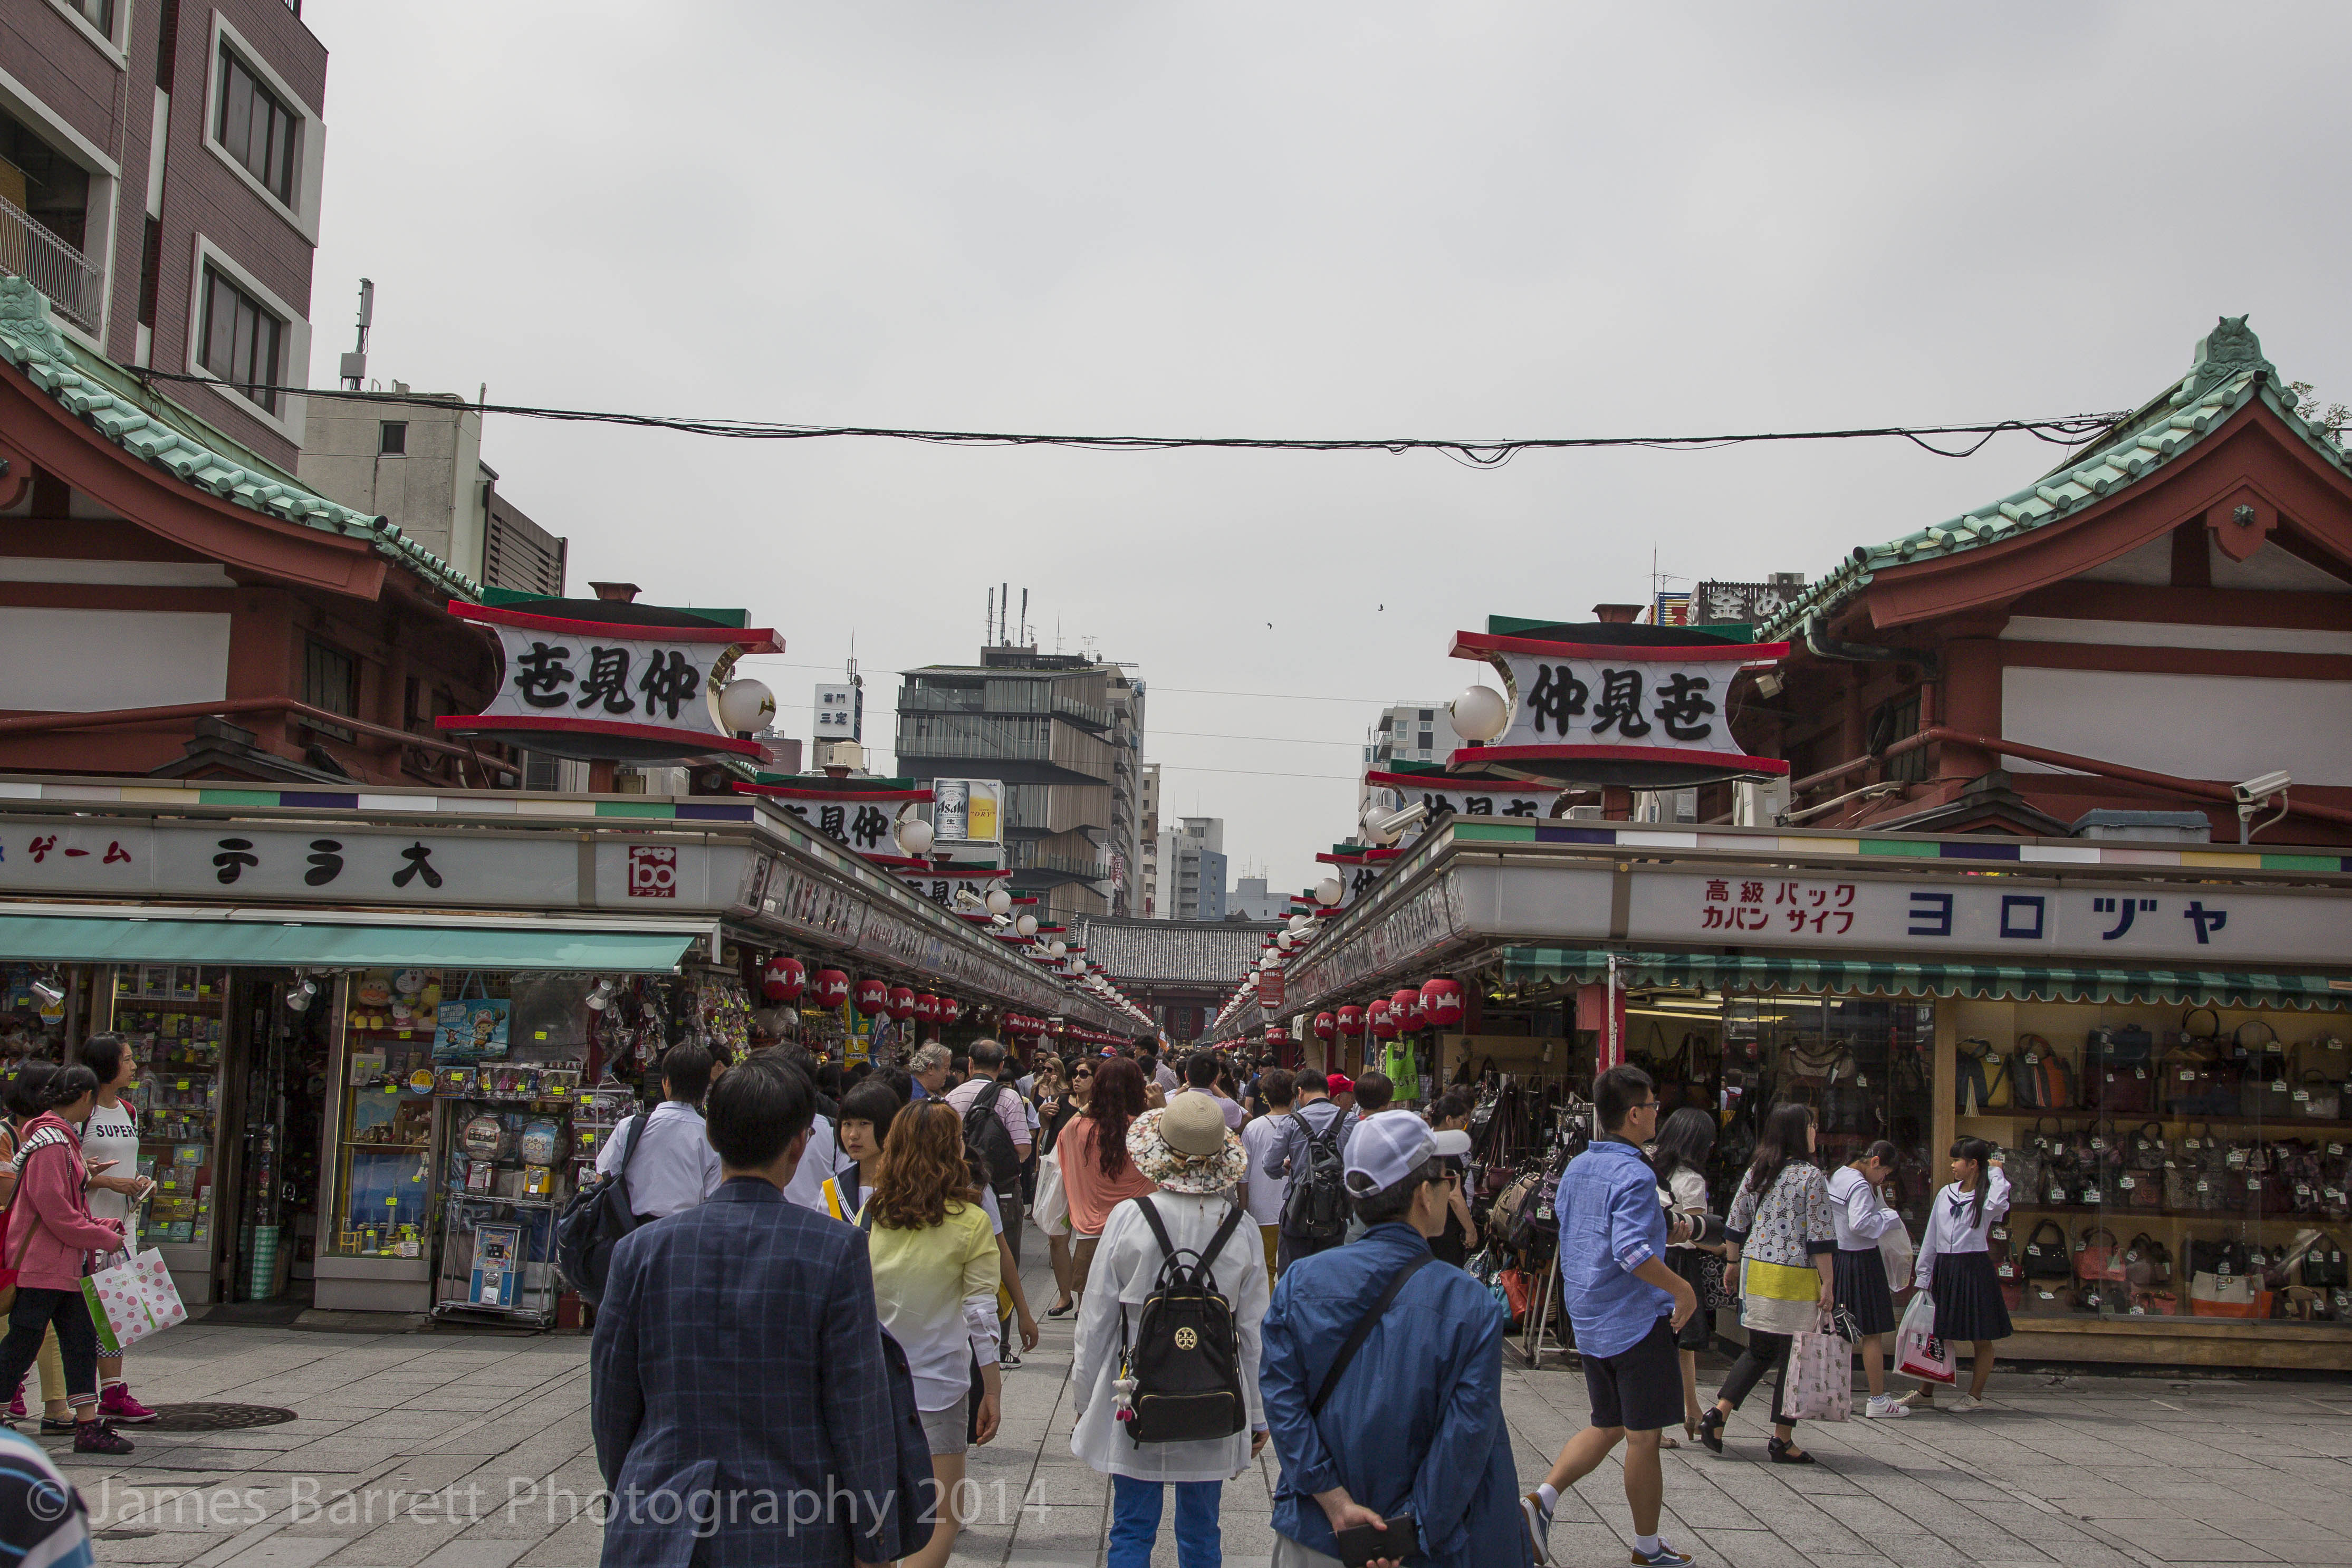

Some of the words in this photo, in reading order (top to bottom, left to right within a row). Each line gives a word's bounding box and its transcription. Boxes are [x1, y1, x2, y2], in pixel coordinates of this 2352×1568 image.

[1527, 663, 1716, 742] 仲見世
[937, 800, 967, 814] Asahi
[28, 835, 131, 863] ゲーム
[1706, 879, 1764, 903] 高級
[1702, 906, 1769, 930] カバン
[1787, 909, 1854, 934] サイフ
[1908, 892, 2227, 944] ヨロヅヤ
[96, 1124, 135, 1138] SUPER
